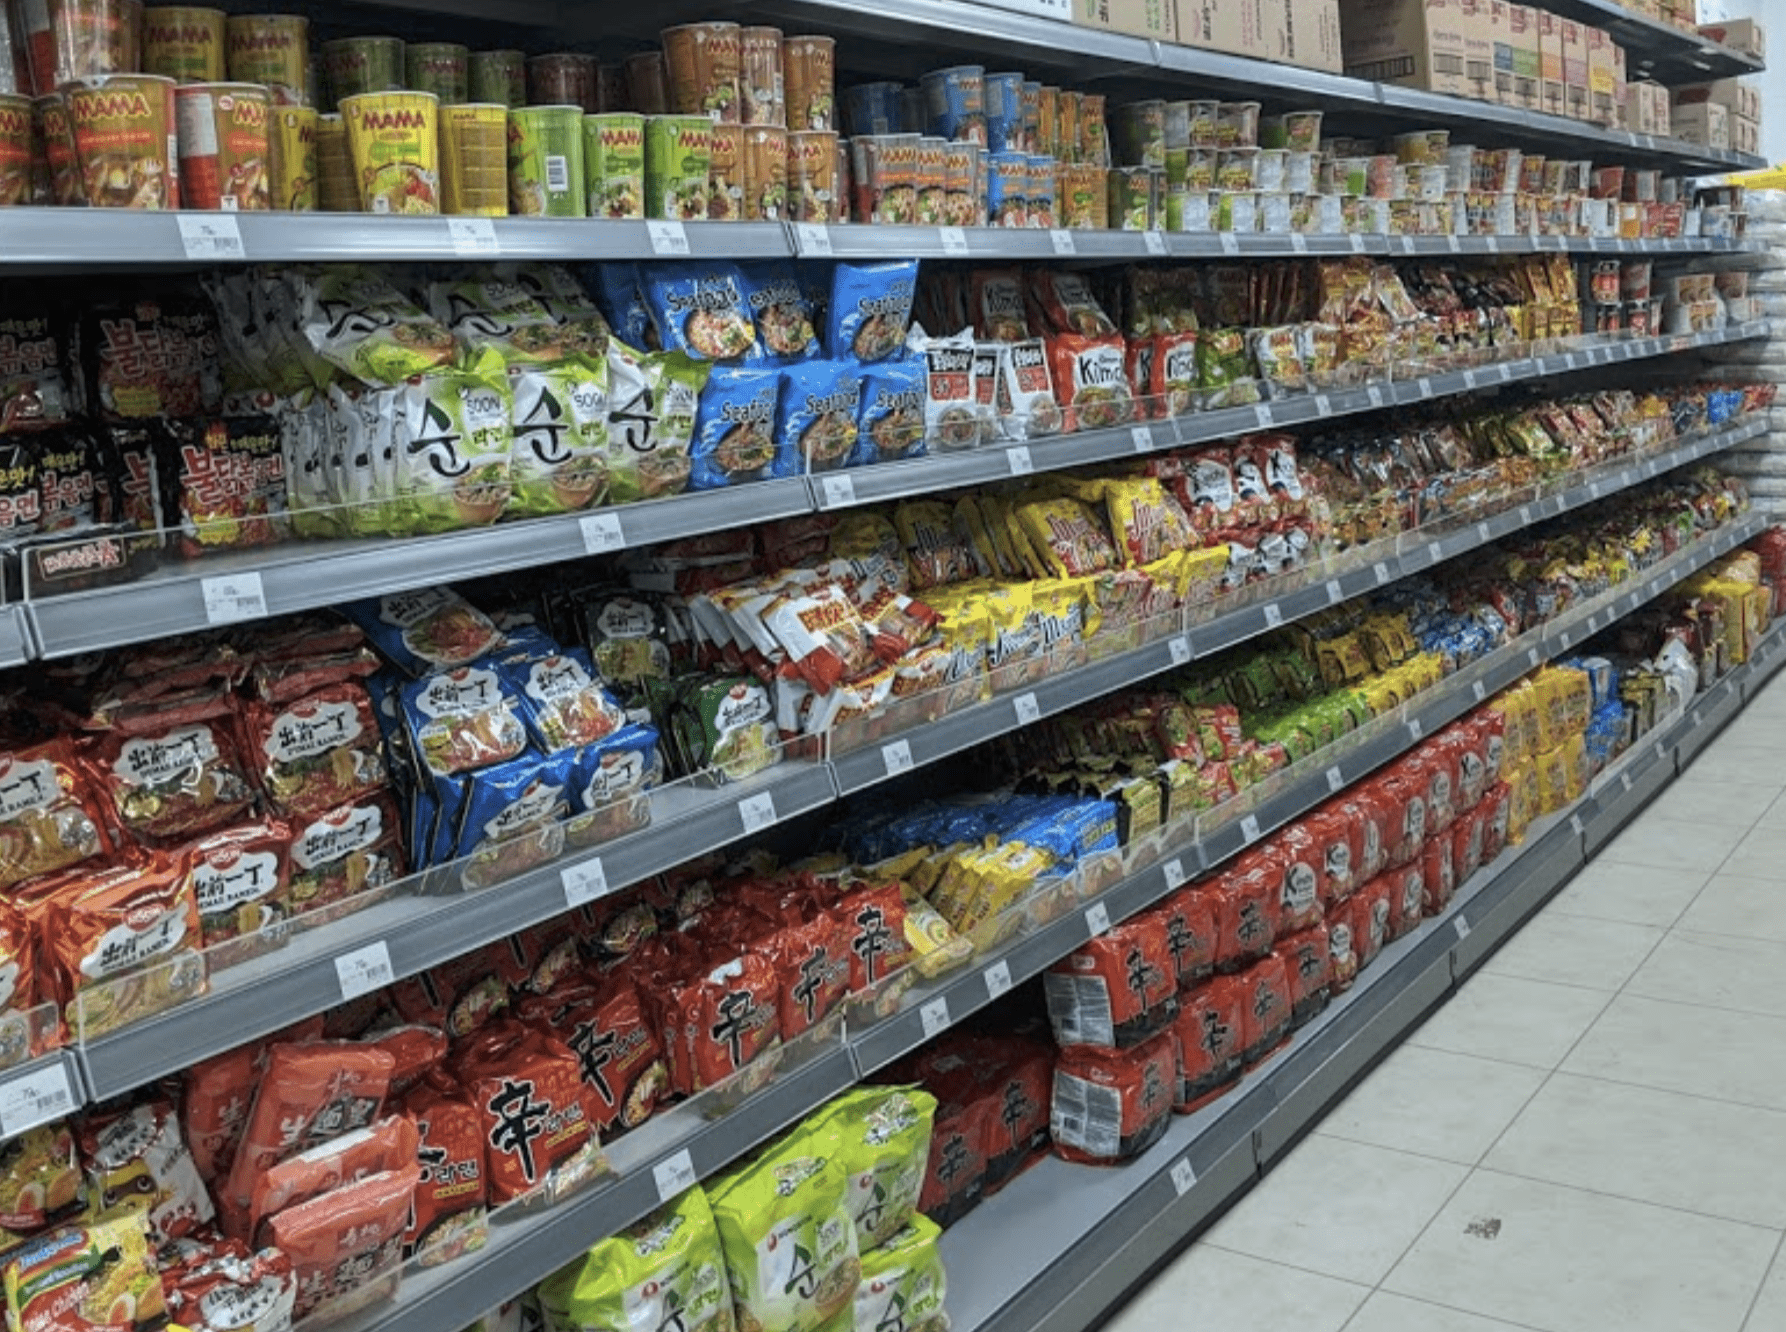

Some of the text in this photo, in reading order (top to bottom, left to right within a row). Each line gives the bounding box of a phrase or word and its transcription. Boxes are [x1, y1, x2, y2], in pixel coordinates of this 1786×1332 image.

[74, 92, 151, 121] MAMA
[362, 108, 426, 131] MAMA
[406, 397, 471, 478] 순
[277, 710, 345, 749] 出前一丁
[853, 904, 890, 989] 辛
[566, 1018, 615, 1107] 辛
[712, 991, 753, 1068] 辛
[489, 1078, 552, 1184] 辛
[784, 1242, 822, 1300] 순
